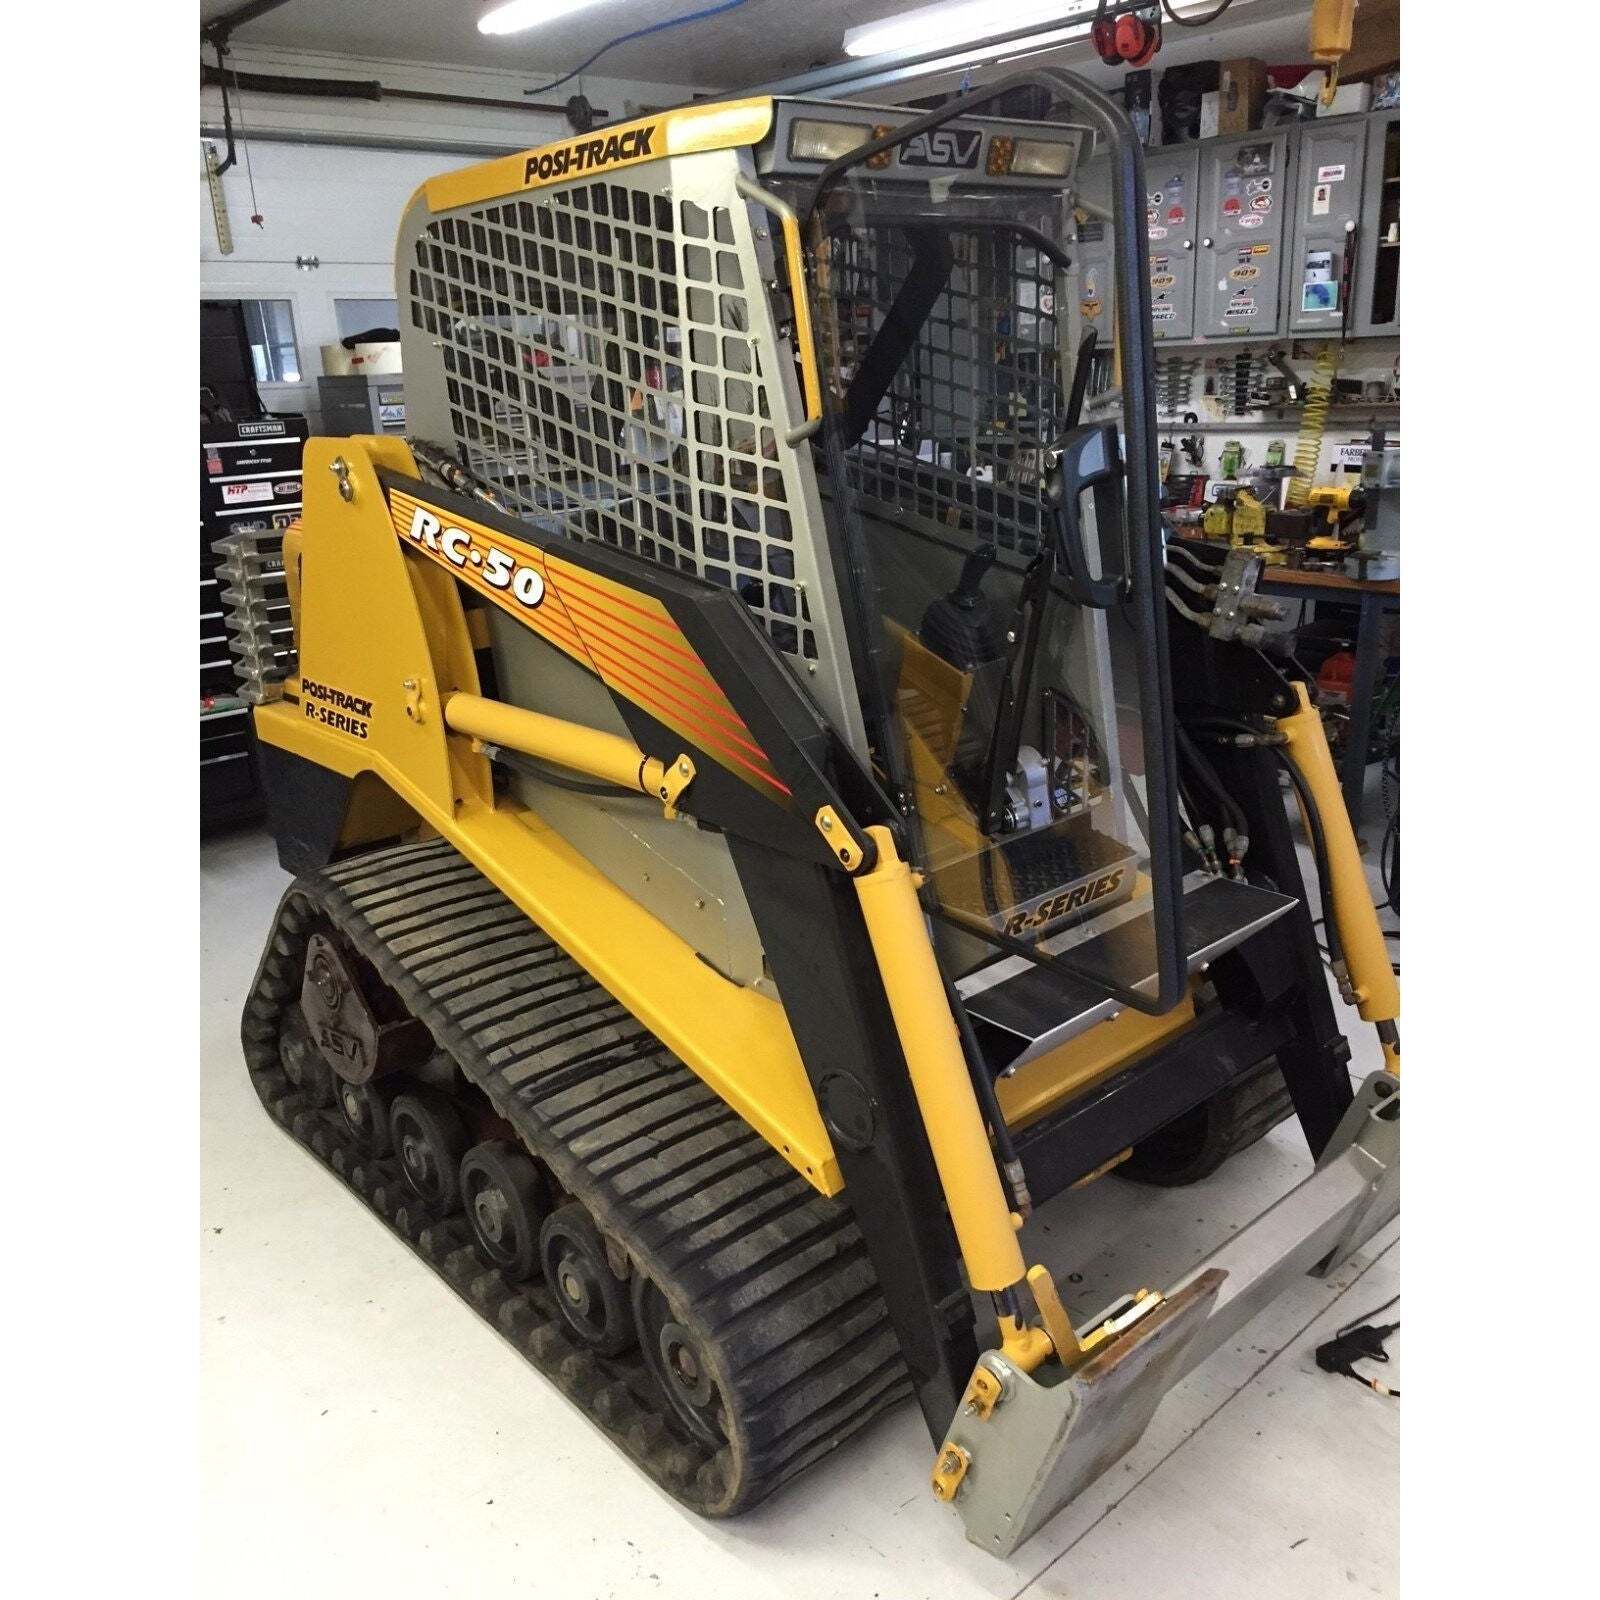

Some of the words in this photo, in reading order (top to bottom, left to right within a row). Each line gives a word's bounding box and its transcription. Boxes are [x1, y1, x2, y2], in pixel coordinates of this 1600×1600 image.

[524, 126, 655, 184] POSI-TRACK
[901, 131, 981, 167] ASV
[241, 423, 283, 434] CRAFTSMAN
[227, 485, 248, 495] HTP
[301, 677, 373, 719] POSI-TRACK
[305, 701, 368, 739] R-SERIES
[1003, 868, 1125, 937] R-SERIES
